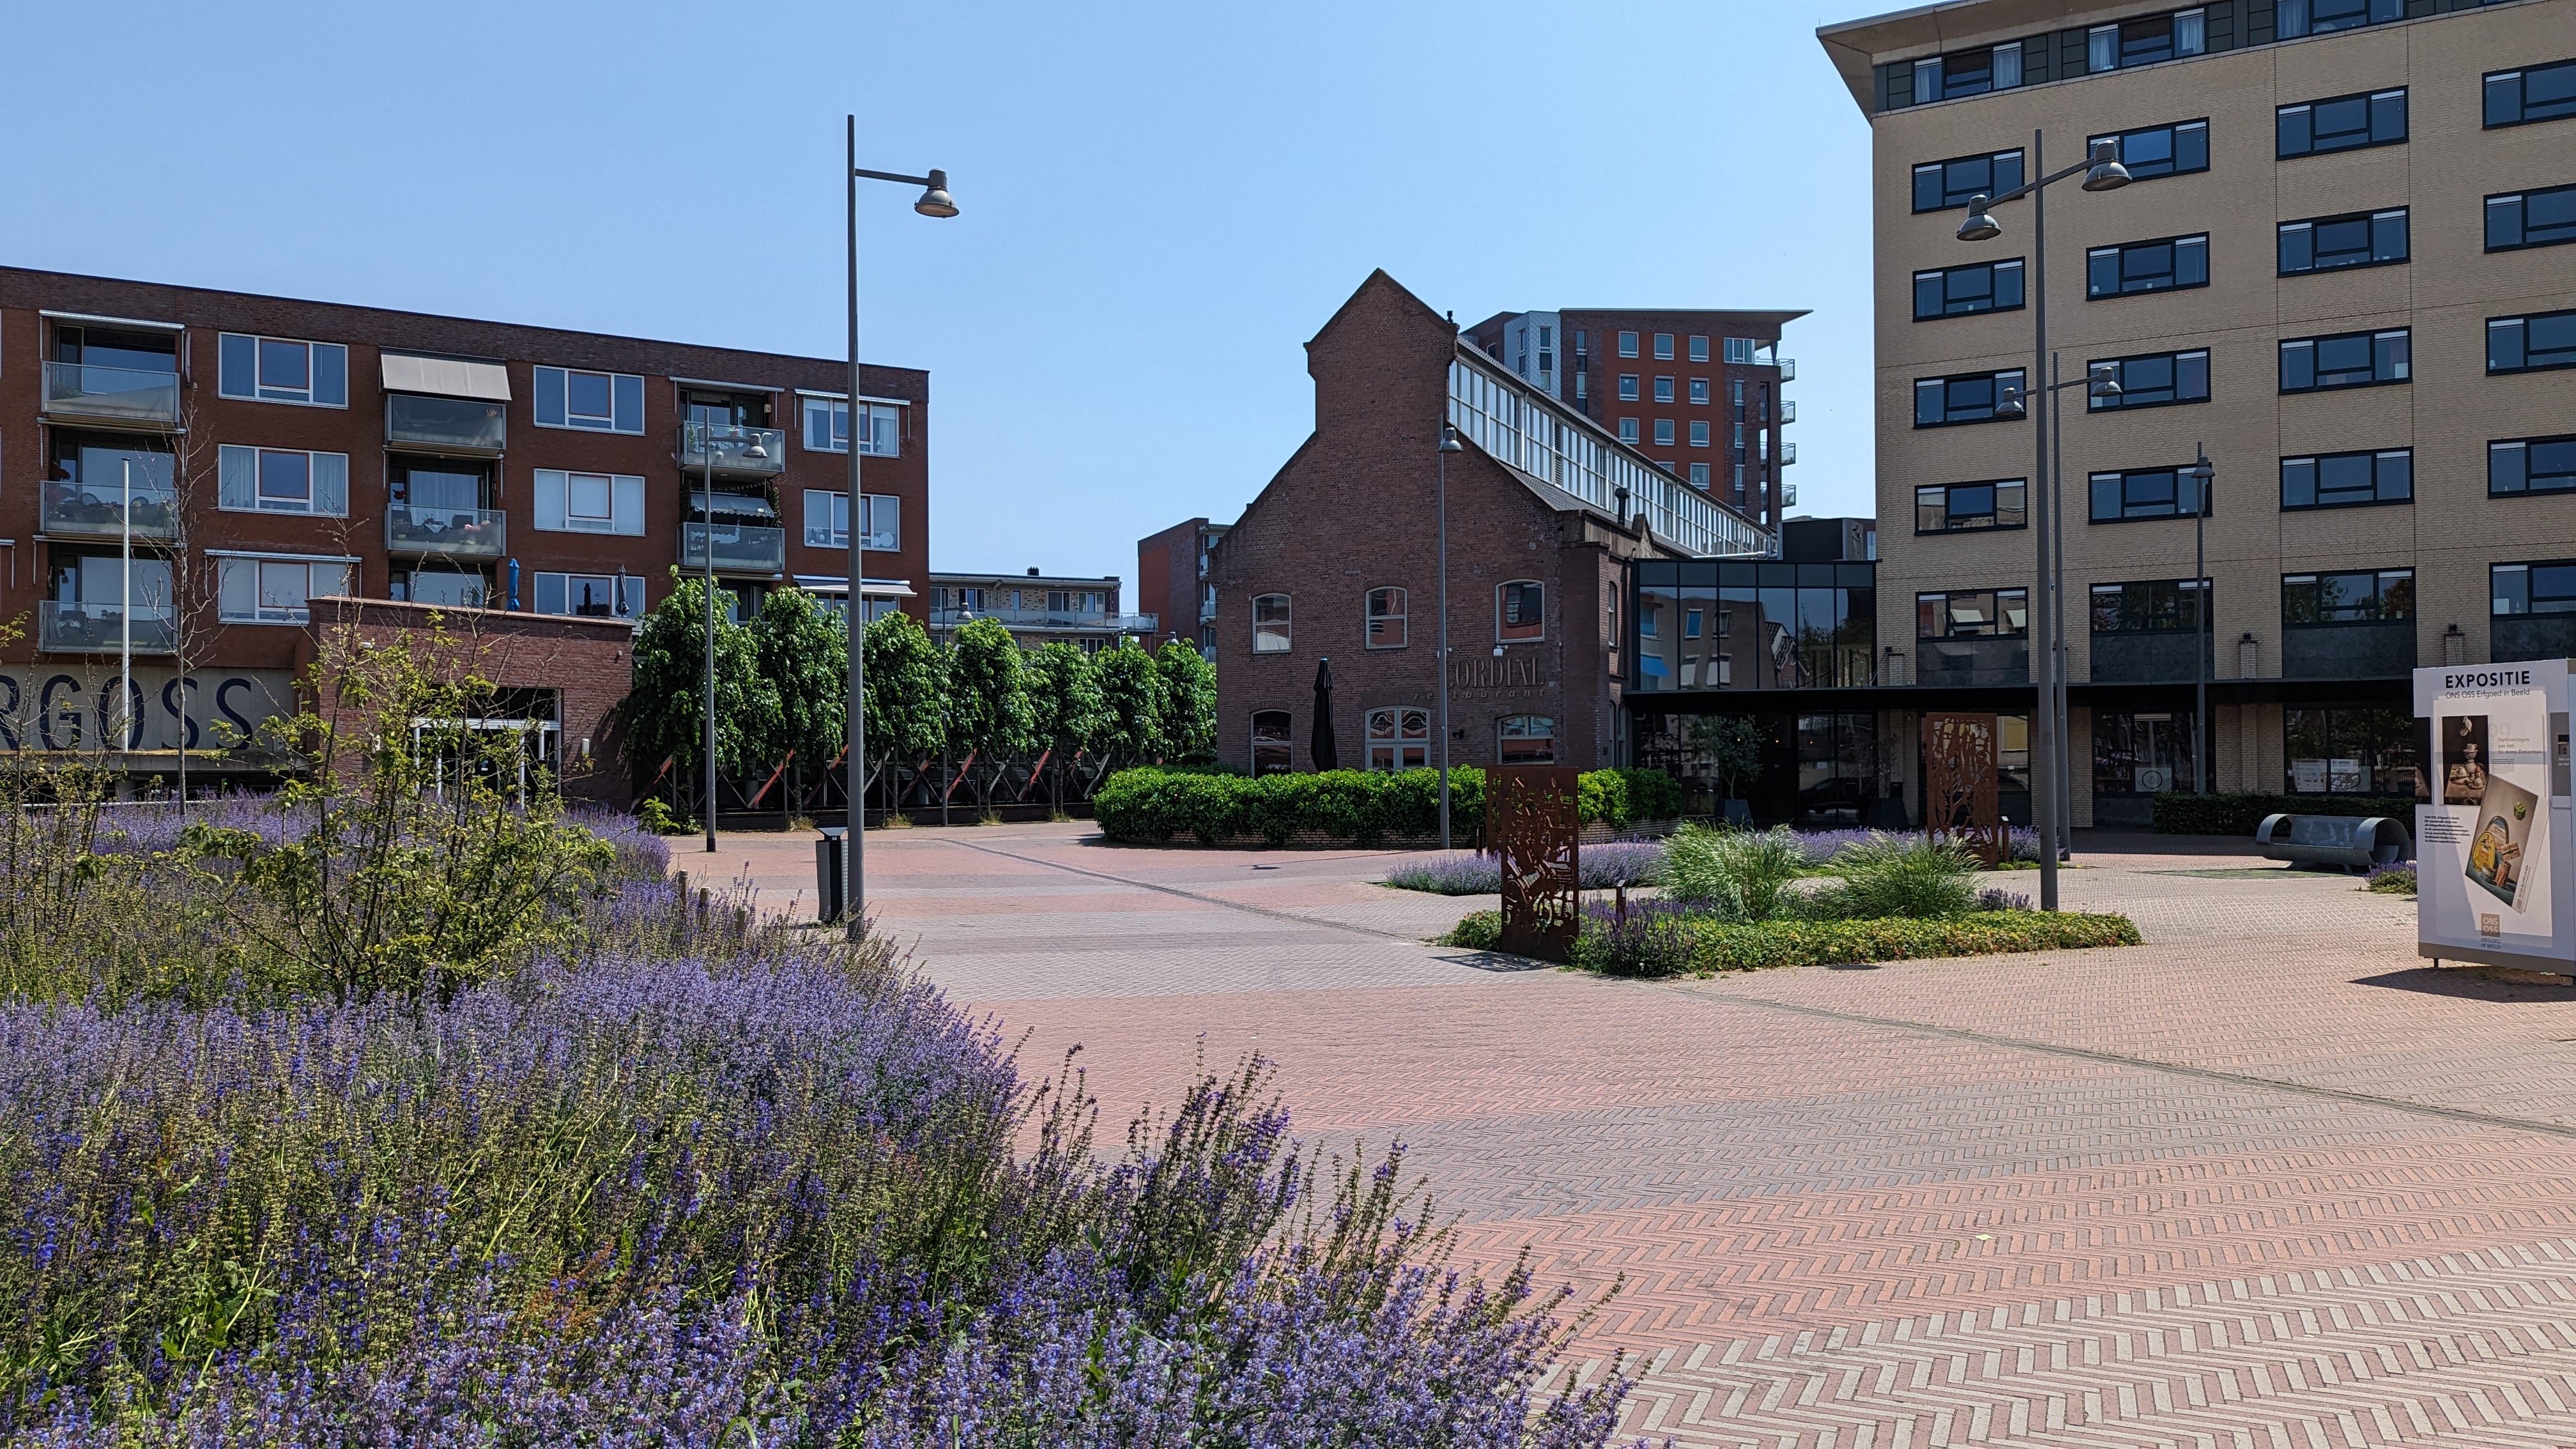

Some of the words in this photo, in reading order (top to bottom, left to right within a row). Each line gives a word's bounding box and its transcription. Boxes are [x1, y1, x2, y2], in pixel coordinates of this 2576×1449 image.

[2446, 671, 2531, 689] EXPOSITIE
[1414, 688, 1545, 700] retaurant
[2477, 690, 2502, 700] Erfgoed
[2511, 688, 2531, 696] Beeld
[2483, 917, 2498, 925] ONS
